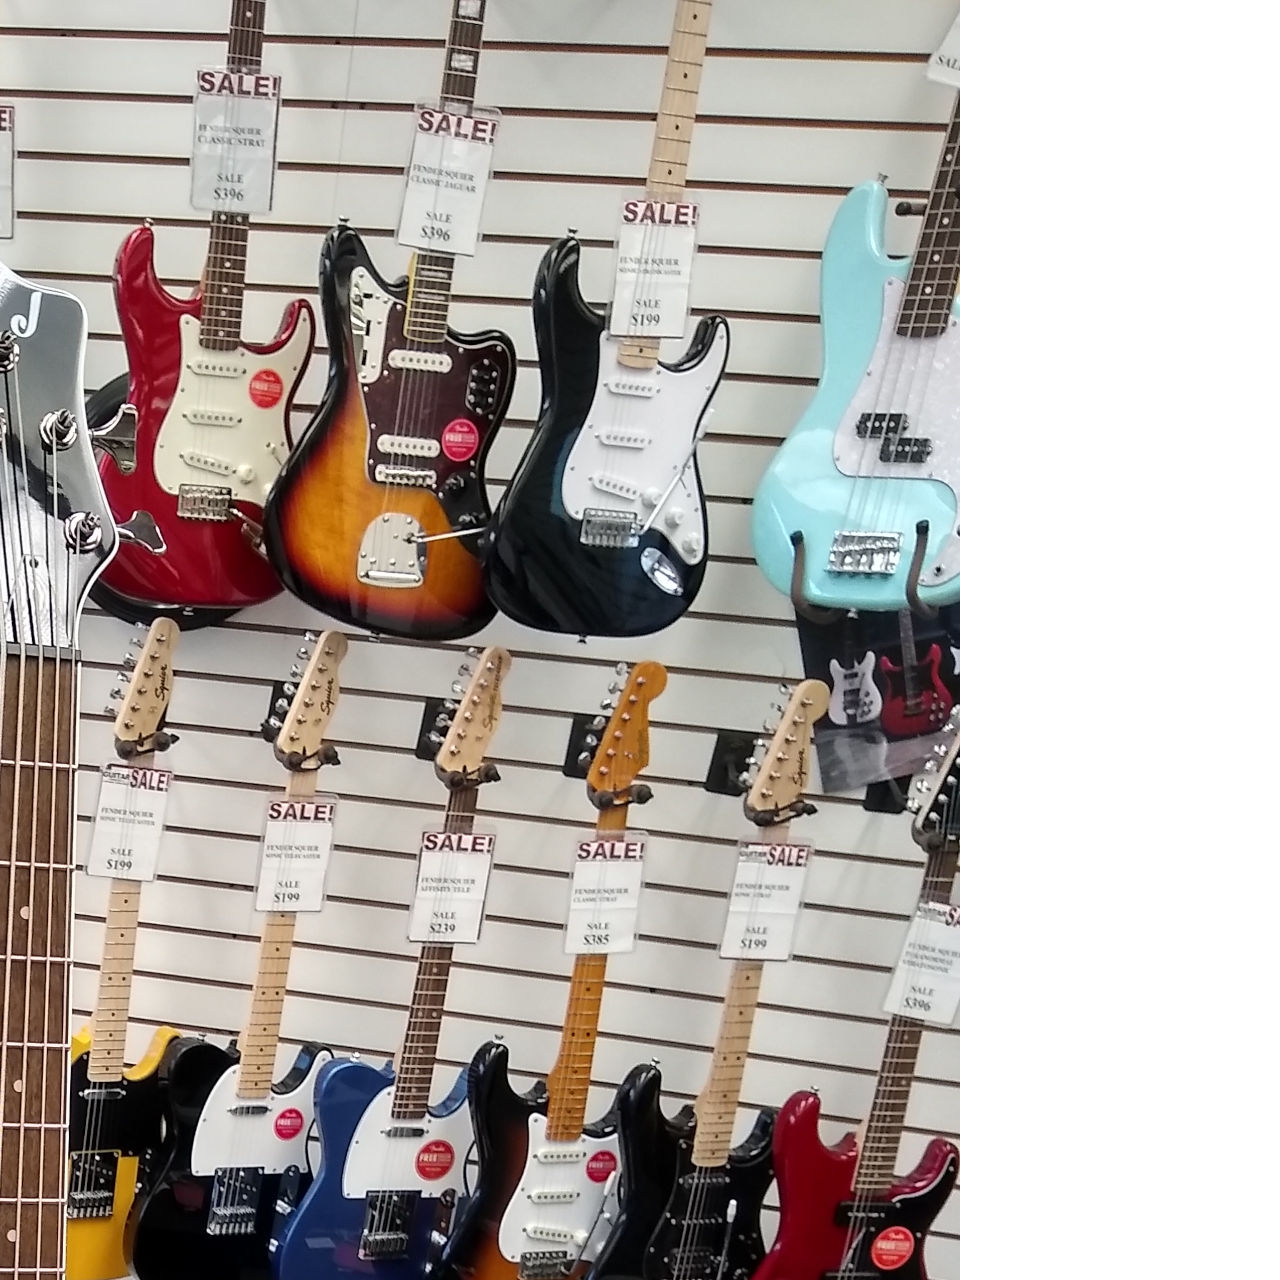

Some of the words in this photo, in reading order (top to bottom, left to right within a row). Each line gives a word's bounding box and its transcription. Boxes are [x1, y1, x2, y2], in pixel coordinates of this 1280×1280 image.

[200, 71, 277, 98] SALE!
[418, 109, 496, 143] SALE!
[217, 173, 244, 184] SALE
[214, 187, 244, 201] $396
[425, 210, 452, 223] SALE
[623, 201, 696, 225] SALE!
[421, 227, 450, 241] $396
[635, 299, 661, 309] SALE
[631, 313, 660, 327] $199
[155, 664, 170, 701] Squier
[320, 677, 335, 715] Squier
[792, 748, 808, 787] Squier
[129, 769, 170, 792] SALE!
[268, 801, 333, 820] SALE!
[424, 833, 493, 853] SALE!
[110, 847, 133, 857] SALE
[577, 841, 644, 860] SALE!
[767, 846, 808, 868] SALE!
[106, 859, 132, 871] $199
[278, 880, 301, 889] SALE
[274, 892, 300, 903] $199
[433, 911, 456, 920] SALE
[430, 924, 456, 934] $239
[587, 922, 609, 930] SALE
[745, 926, 768, 935] SALE
[583, 934, 610, 946] $385
[740, 938, 767, 950] $199
[419, 1154, 438, 1163] FREE
